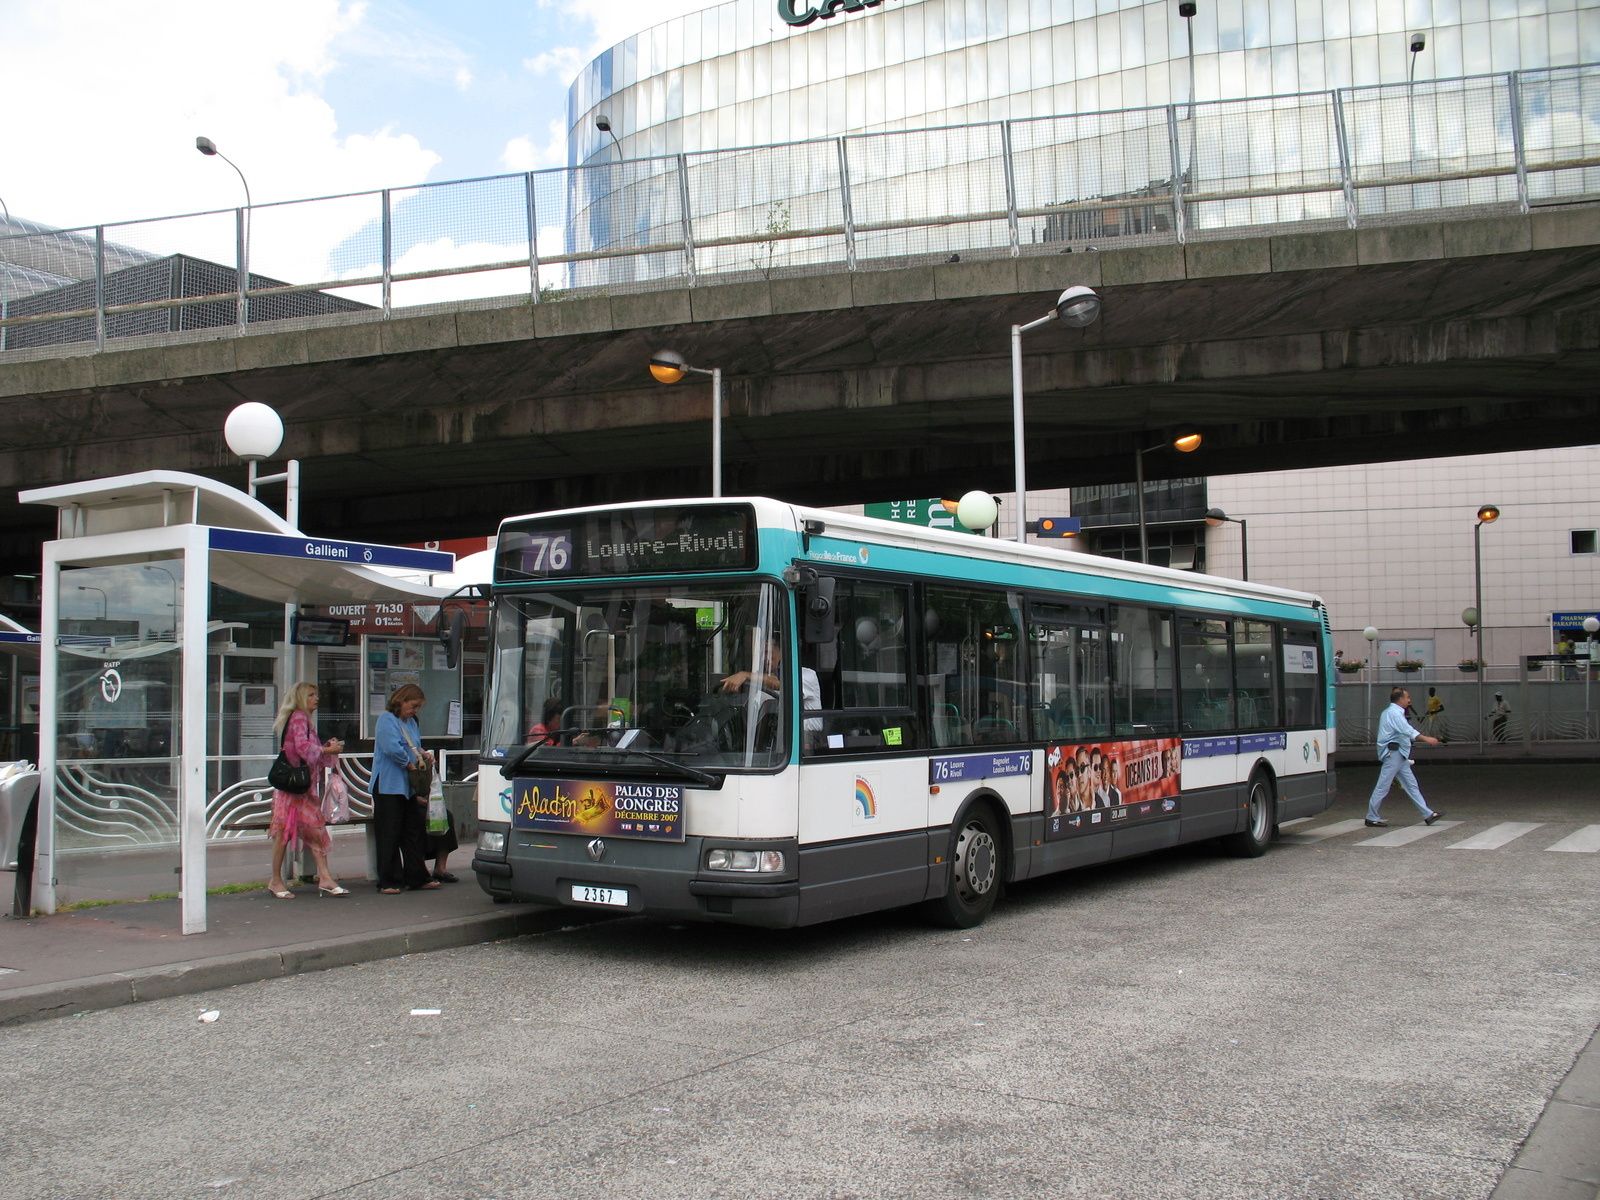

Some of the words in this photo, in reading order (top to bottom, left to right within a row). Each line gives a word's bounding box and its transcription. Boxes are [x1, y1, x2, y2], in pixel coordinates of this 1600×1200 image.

[305, 543, 349, 558] Gallieni
[587, 530, 744, 559] Louvre-Rivoli
[531, 536, 568, 571] 76
[329, 604, 367, 616] OUVERT
[375, 603, 404, 614] 7h30
[361, 618, 366, 626] 7
[1184, 743, 1193, 756] 76
[935, 762, 949, 779] 76
[1019, 755, 1030, 772] 76
[1151, 755, 1159, 779] 13
[615, 785, 653, 798] PALAIS
[655, 787, 679, 799] DES
[517, 786, 577, 820] Aladin
[614, 795, 679, 813] CONGRÈS
[614, 810, 659, 821] DÉCEMBRE
[660, 814, 679, 823] 2007
[584, 888, 613, 904] 2367
